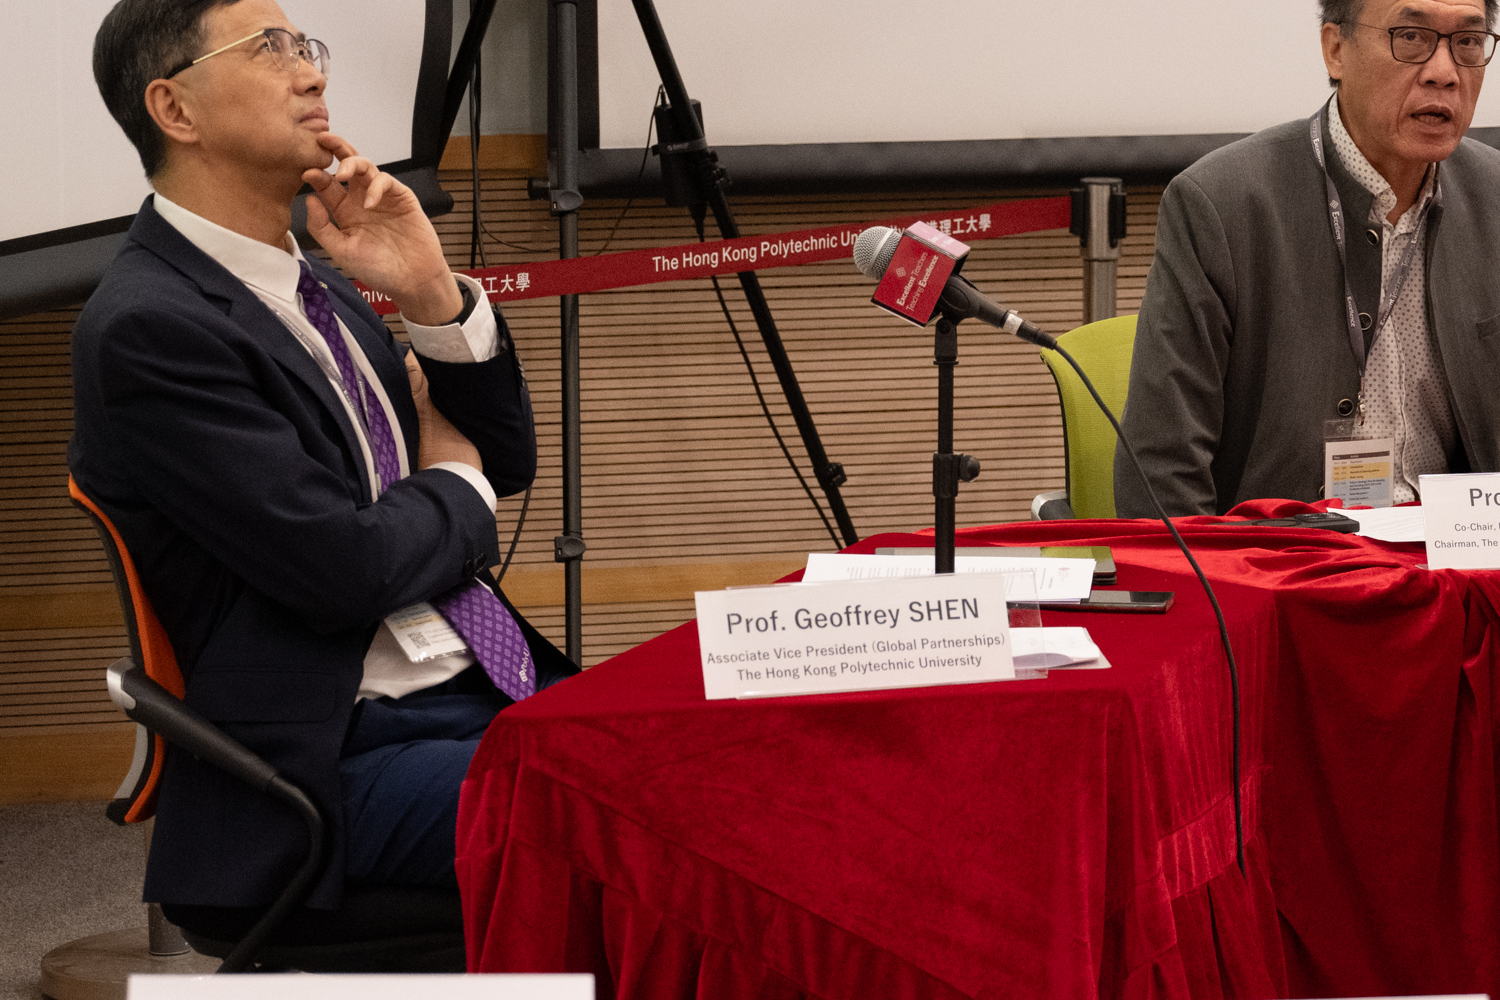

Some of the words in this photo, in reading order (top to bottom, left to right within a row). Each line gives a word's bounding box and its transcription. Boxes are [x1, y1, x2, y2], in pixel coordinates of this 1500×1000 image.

[926, 213, 992, 236] 理工大學
[652, 255, 679, 273] The
[682, 249, 719, 271] Hong
[722, 244, 758, 267] Kong
[760, 234, 838, 259] Polytechnic
[840, 223, 906, 247] Unity
[474, 272, 531, 294] 工大學
[896, 276, 916, 306] Excellent
[911, 251, 928, 276] Teachers
[906, 286, 924, 311] Teaching
[918, 255, 939, 288] Excellence
[1454, 522, 1496, 532] Co-Chair,
[1433, 540, 1480, 550] Chairman,
[1481, 539, 1499, 548] The
[727, 610, 785, 634] Prof.
[795, 605, 899, 629] Geoffrey
[909, 598, 978, 622] SHEN
[708, 651, 769, 663] Associate
[773, 648, 801, 659] Vice
[806, 643, 867, 657] President
[872, 639, 917, 652] (Global
[921, 635, 1004, 649] Partnerships)
[737, 669, 761, 680] The
[766, 668, 800, 679] Hong
[803, 665, 837, 677] Kong
[840, 660, 914, 674] Polytechnic
[919, 655, 981, 668] University
